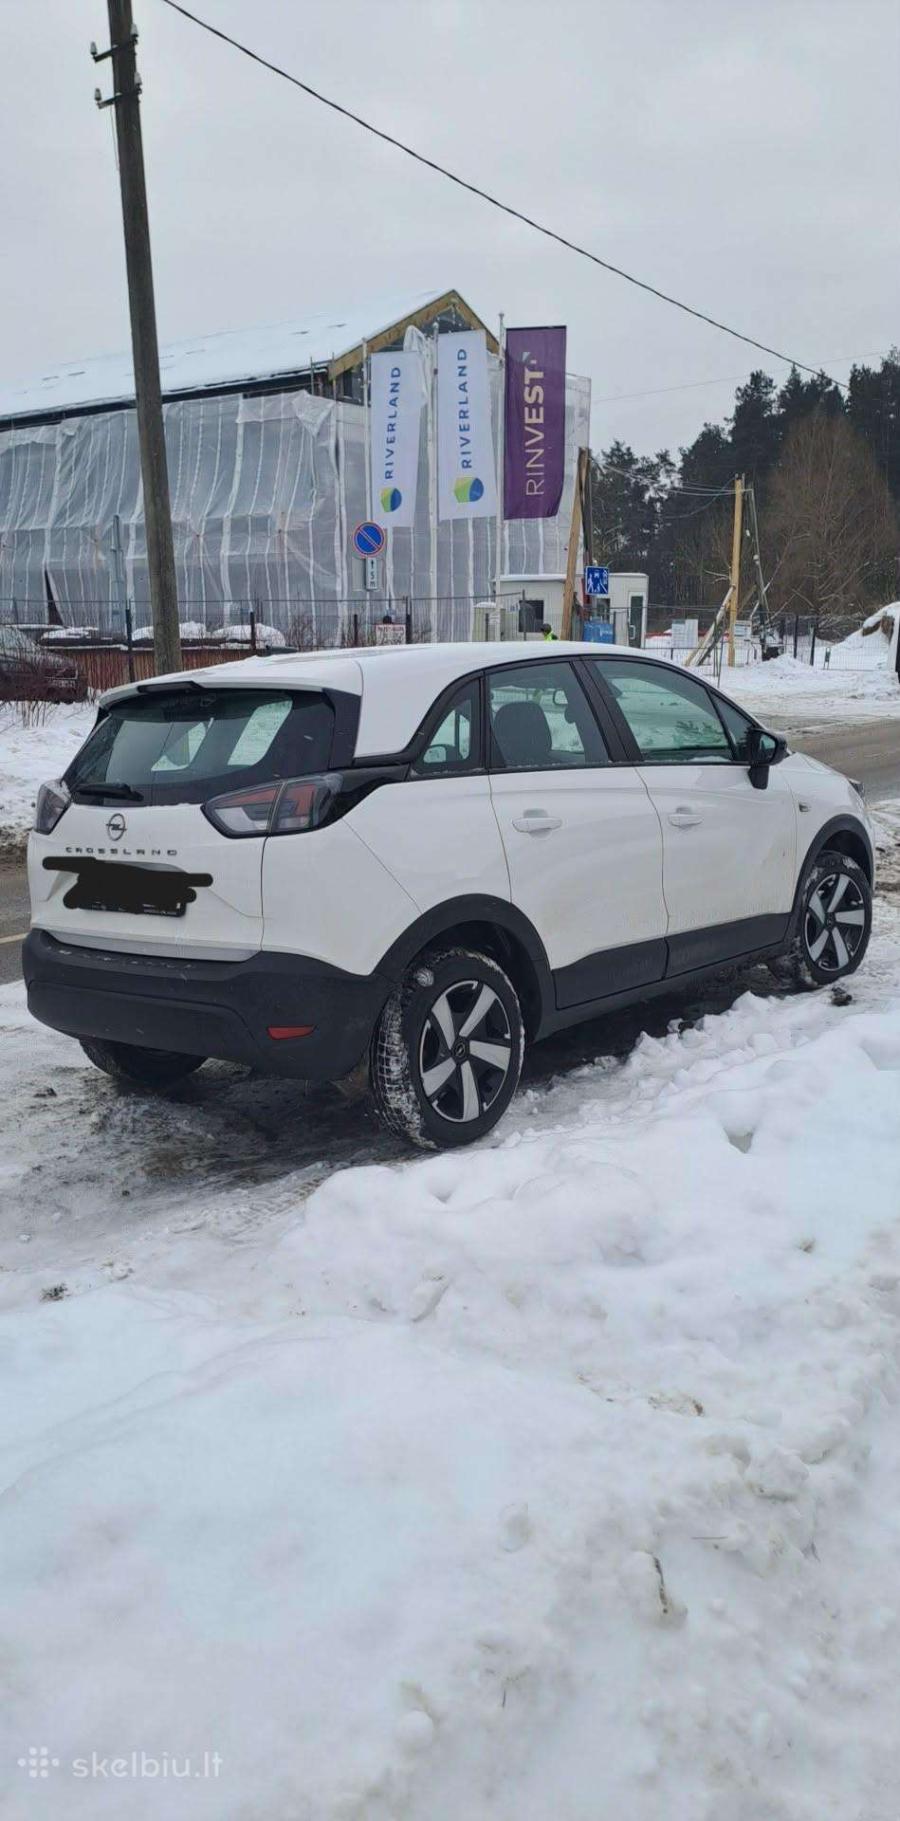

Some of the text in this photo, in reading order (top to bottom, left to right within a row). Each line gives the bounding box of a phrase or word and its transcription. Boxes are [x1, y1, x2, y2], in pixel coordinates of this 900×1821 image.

[384, 366, 401, 480] RIVERLAND
[457, 348, 473, 469] RIVERLAND
[523, 367, 545, 496] RINVEST
[65, 846, 177, 856] CROSSLAND
